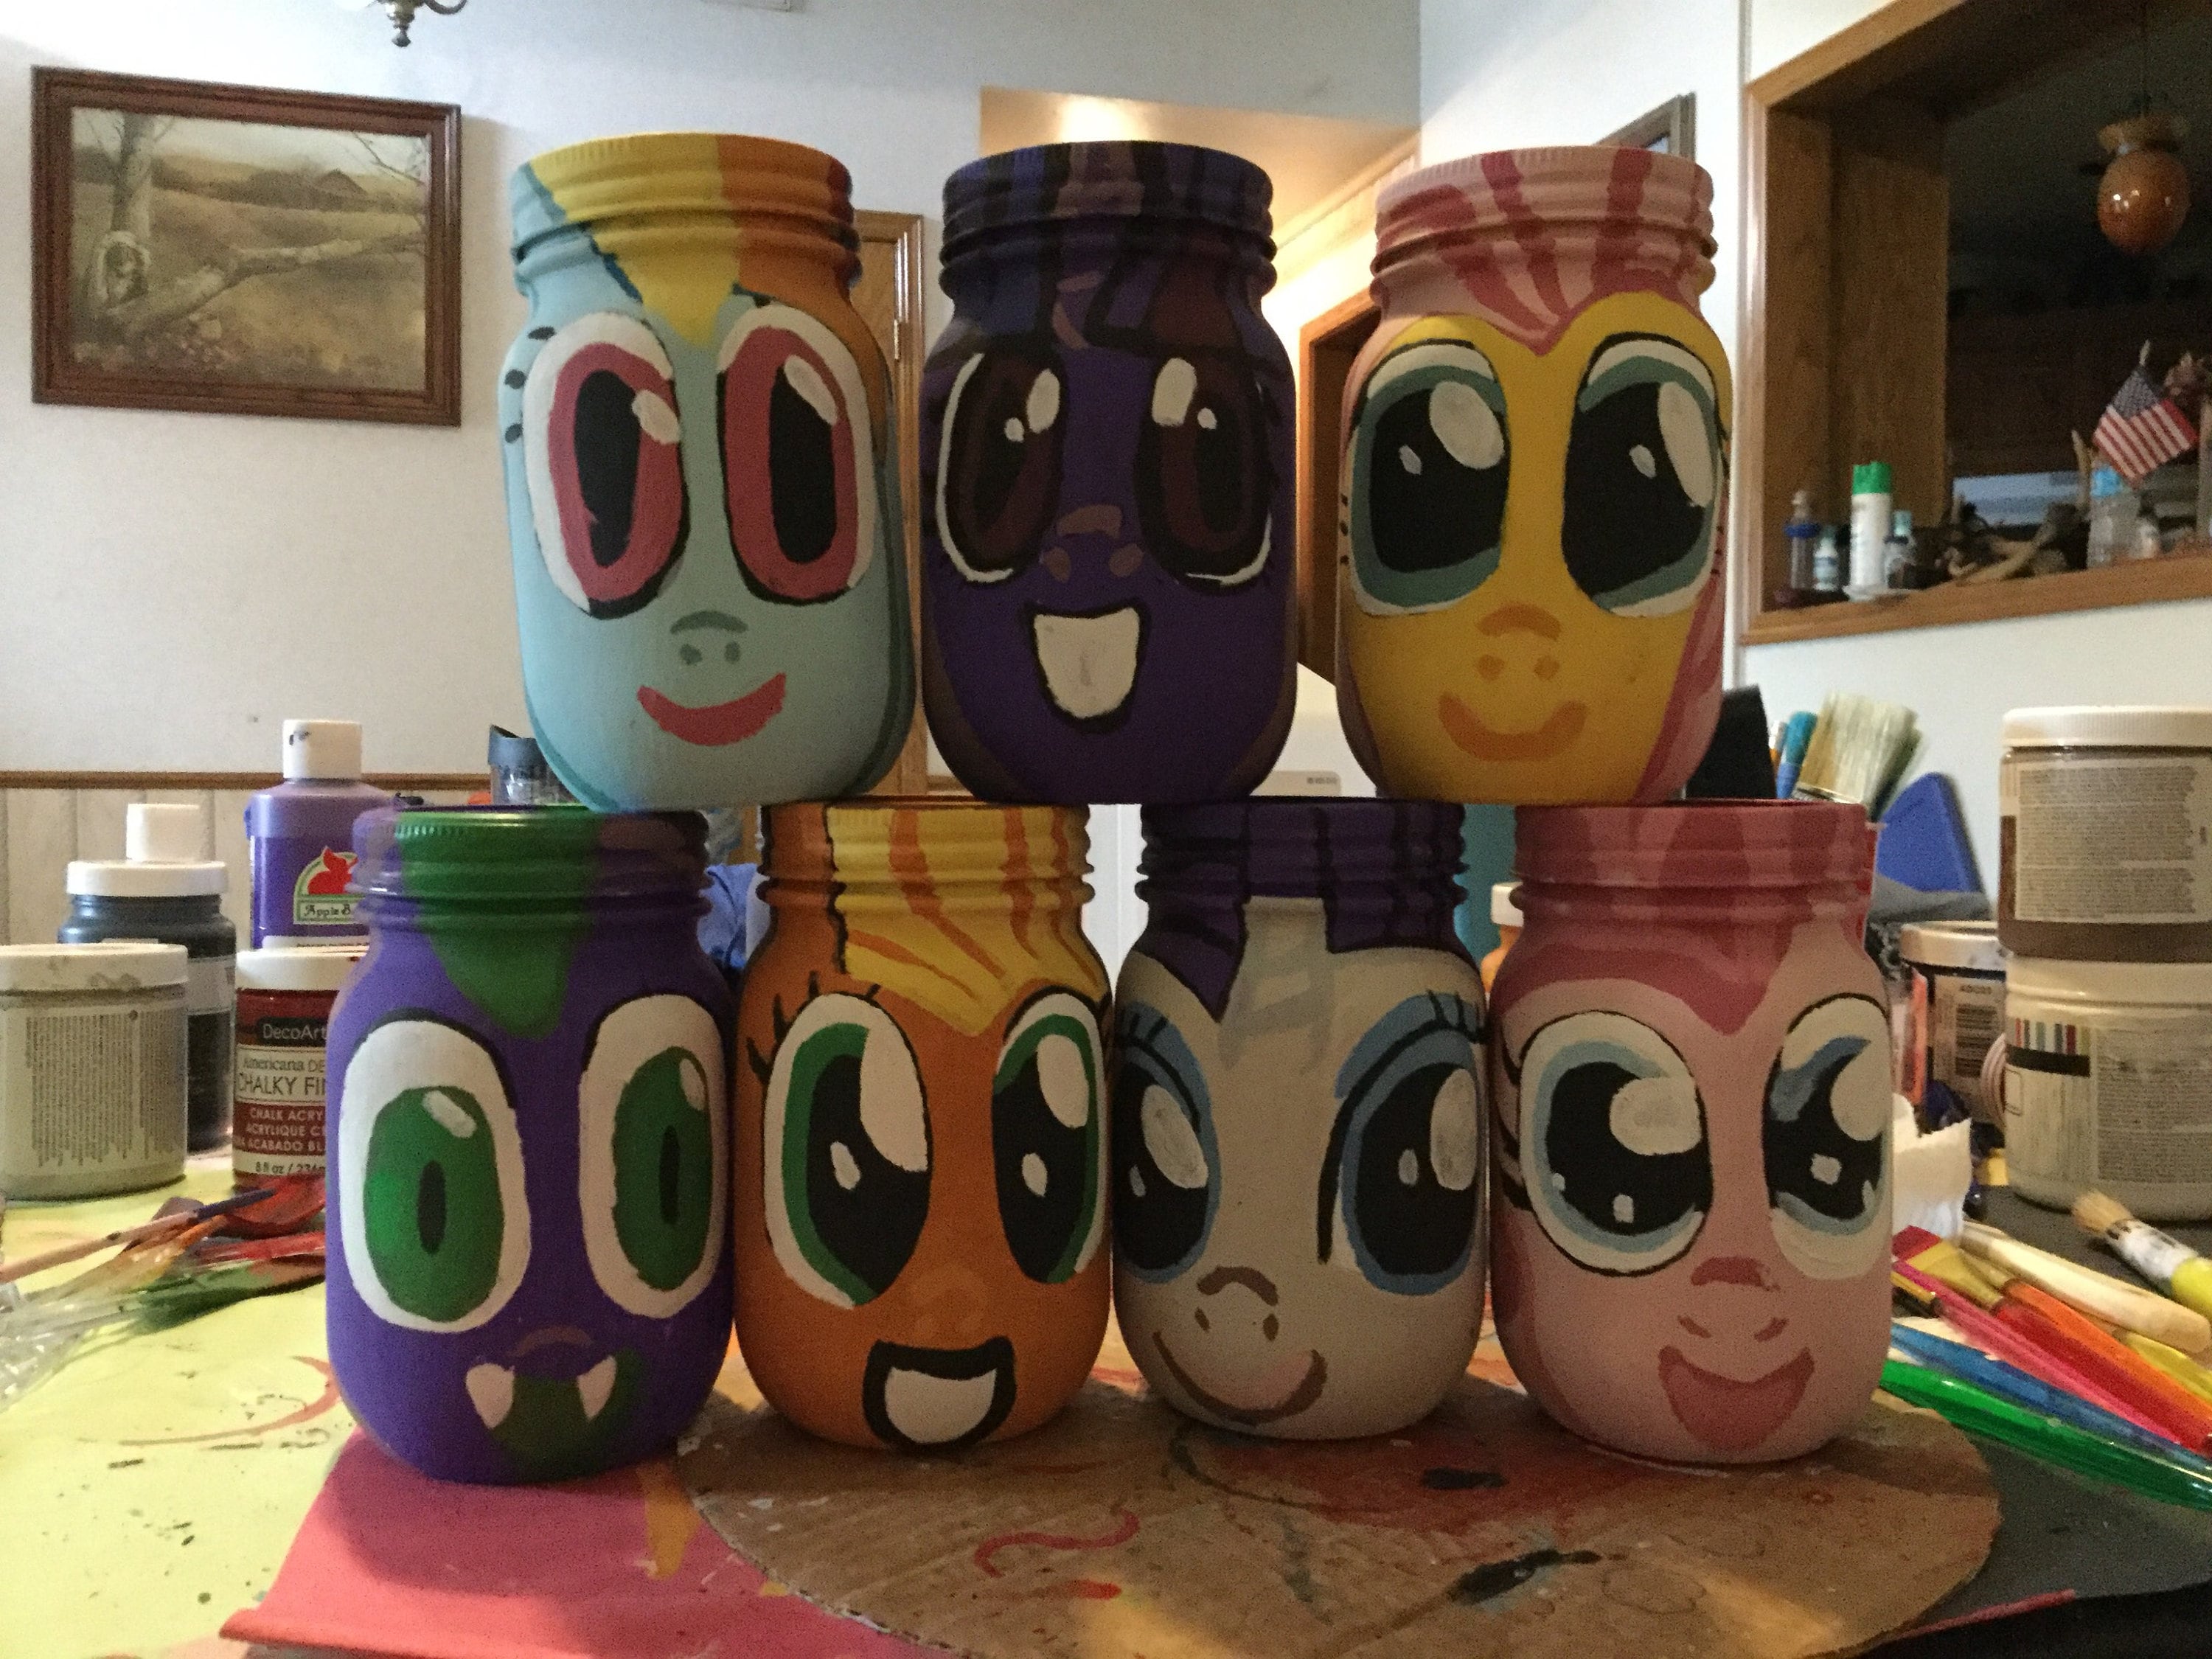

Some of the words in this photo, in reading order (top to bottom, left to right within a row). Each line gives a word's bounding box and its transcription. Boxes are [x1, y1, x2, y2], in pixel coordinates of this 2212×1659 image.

[303, 904, 339, 917] Apple
[262, 1023, 327, 1040] DecoArt
[244, 1057, 304, 1071] Americana
[237, 1072, 298, 1096] CHALKY
[249, 1107, 283, 1121] CHALK
[246, 1123, 306, 1136] ACRYLIQUE
[248, 1138, 303, 1152] ACABADO
[271, 1165, 285, 1174] oz
